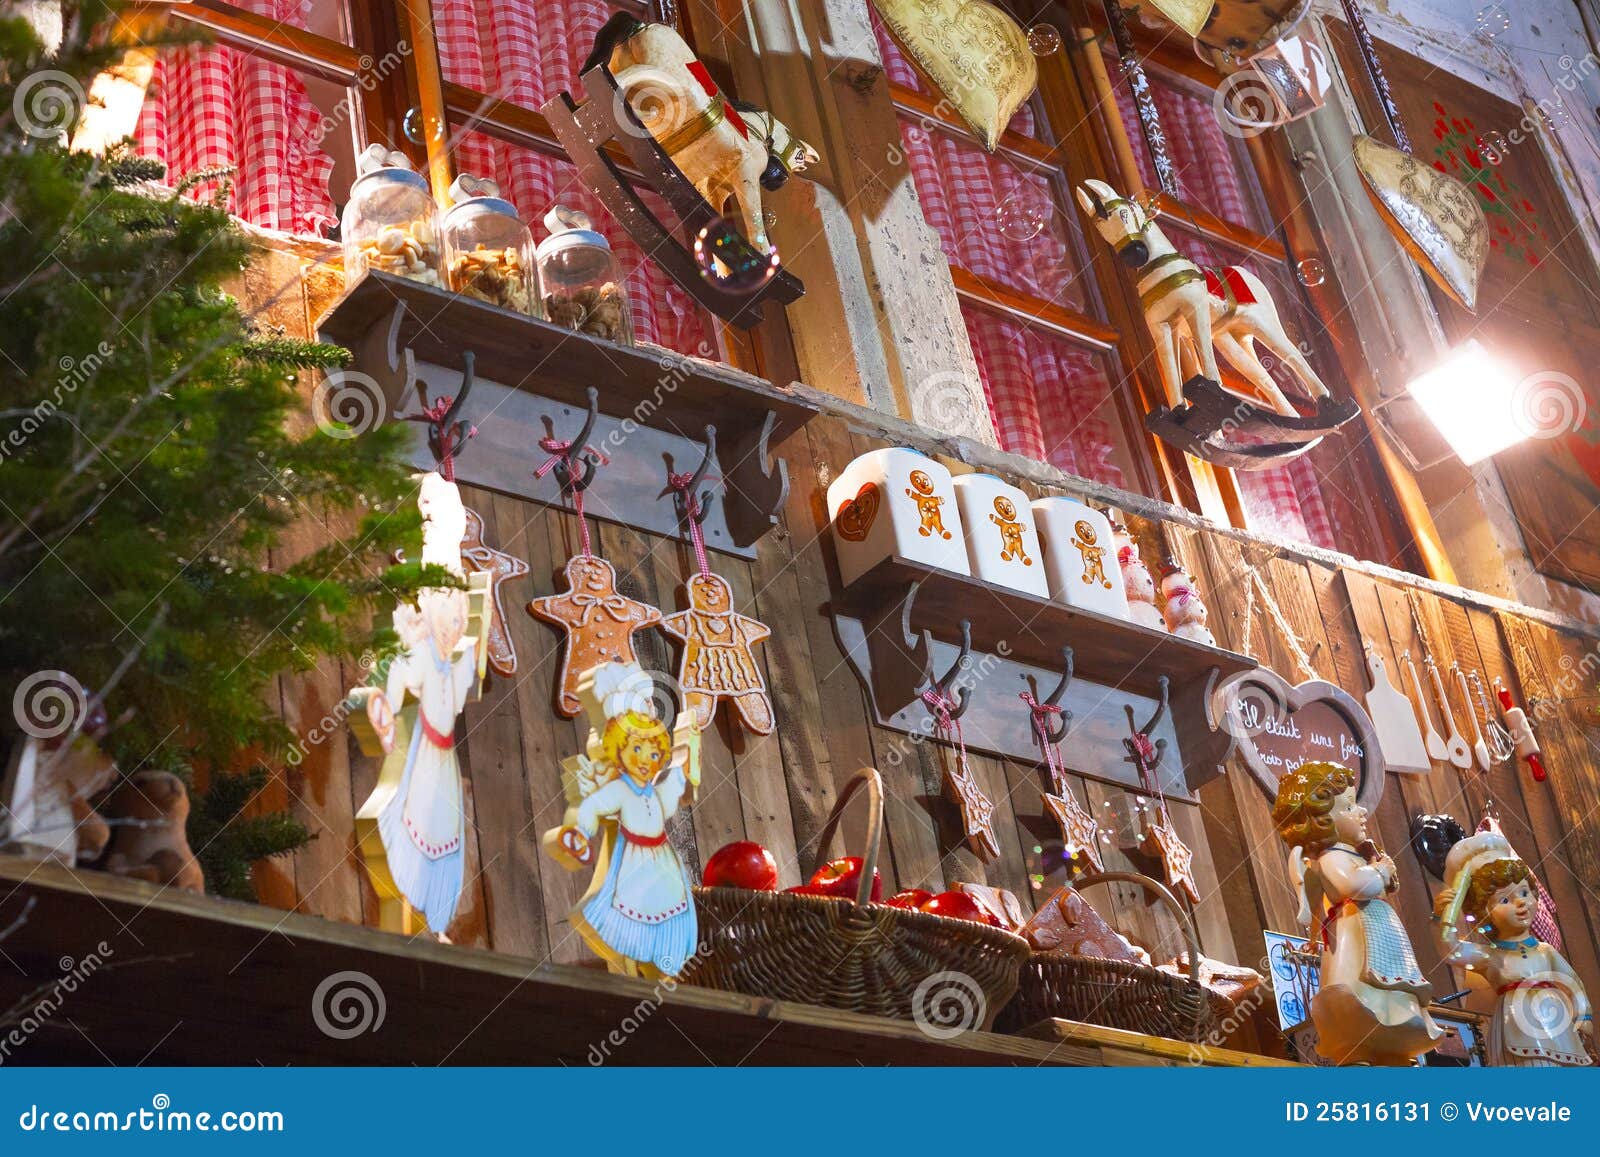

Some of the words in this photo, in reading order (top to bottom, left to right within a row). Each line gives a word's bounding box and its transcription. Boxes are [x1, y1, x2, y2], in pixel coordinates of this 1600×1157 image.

[1238, 699, 1261, 728] Il
[1265, 715, 1301, 739] était
[1310, 732, 1334, 748] une
[1340, 733, 1364, 760] fois
